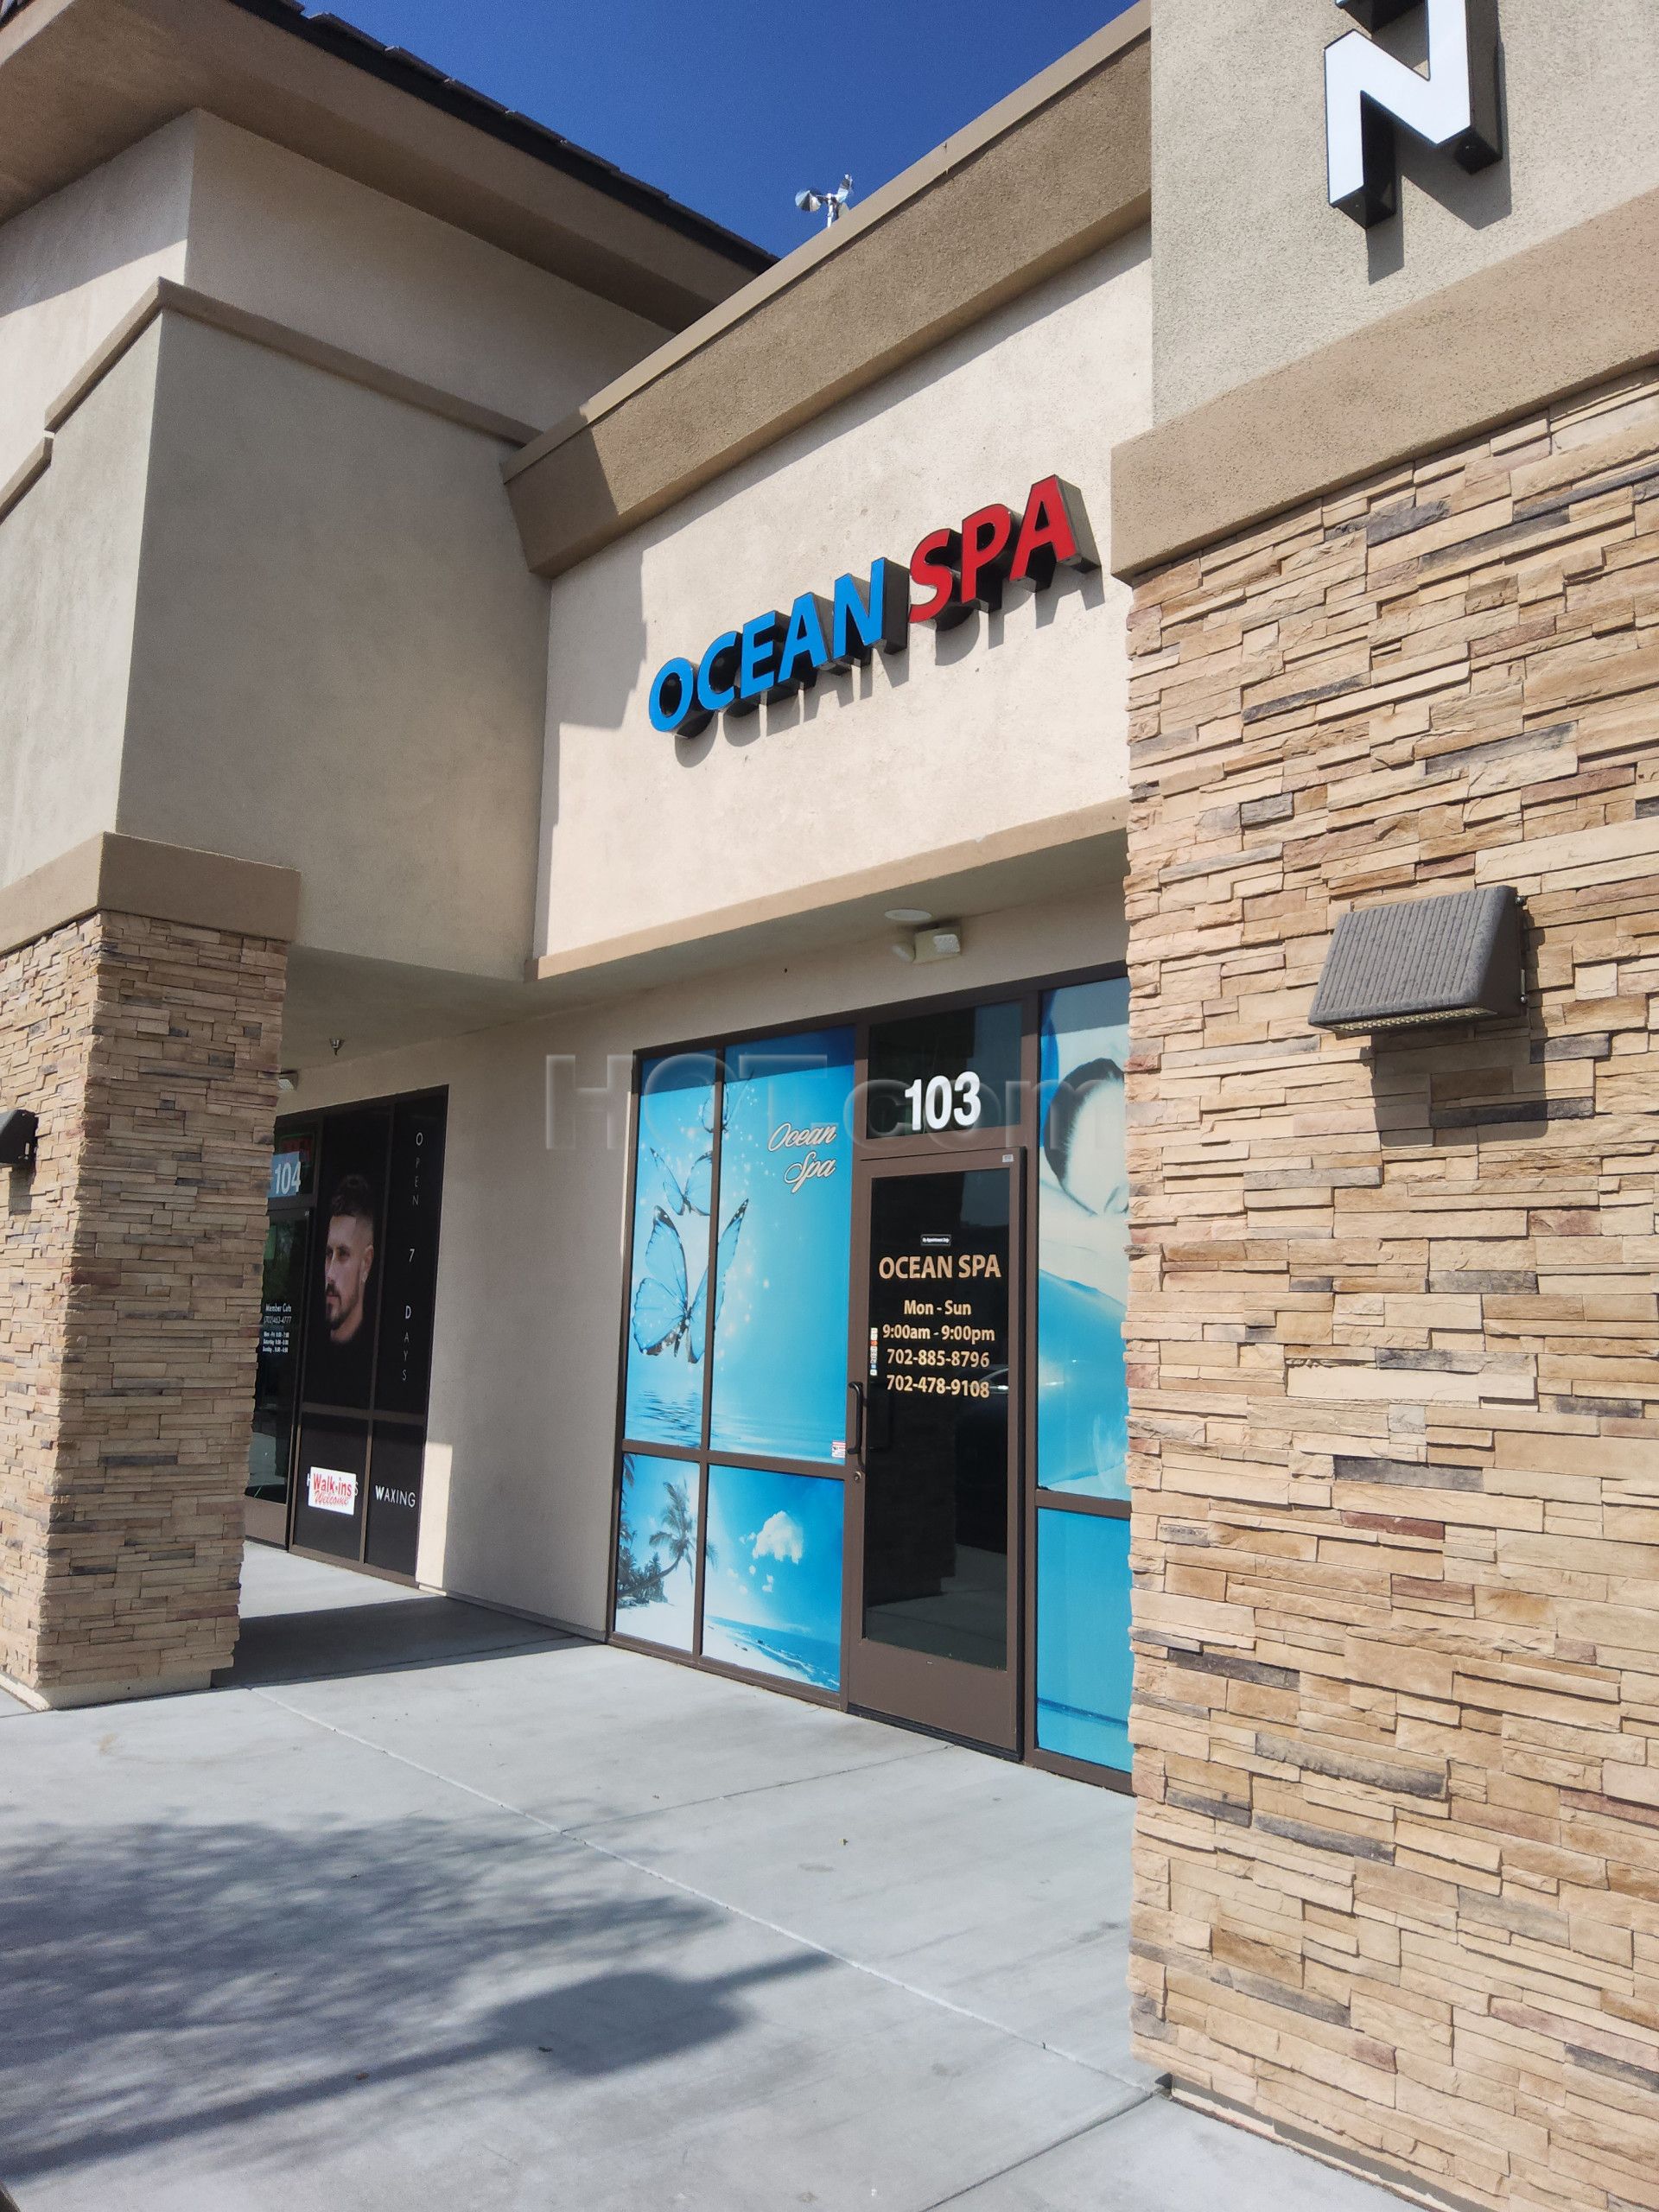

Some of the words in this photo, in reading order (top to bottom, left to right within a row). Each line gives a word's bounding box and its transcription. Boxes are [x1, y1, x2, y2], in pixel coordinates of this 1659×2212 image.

[649, 556, 887, 734] OCEAN
[908, 474, 1078, 625] SPA
[904, 1071, 982, 1132] 103
[766, 1122, 837, 1153] Ocean
[275, 1160, 302, 1195] 104
[784, 1150, 836, 1194] Spa
[879, 1255, 953, 1280] OCEAN
[957, 1254, 1001, 1279] SPA
[903, 1300, 934, 1315] Mon
[944, 1299, 972, 1316] Sun
[882, 1324, 931, 1339] 9:00am
[941, 1325, 995, 1344] 9:00pm
[887, 1348, 989, 1368] 702-885-8796
[887, 1375, 990, 1399] 702-478-9108
[313, 1472, 353, 1497] Walk-ins
[375, 1484, 416, 1509] WAXING
[314, 1491, 350, 1506] Welcome
